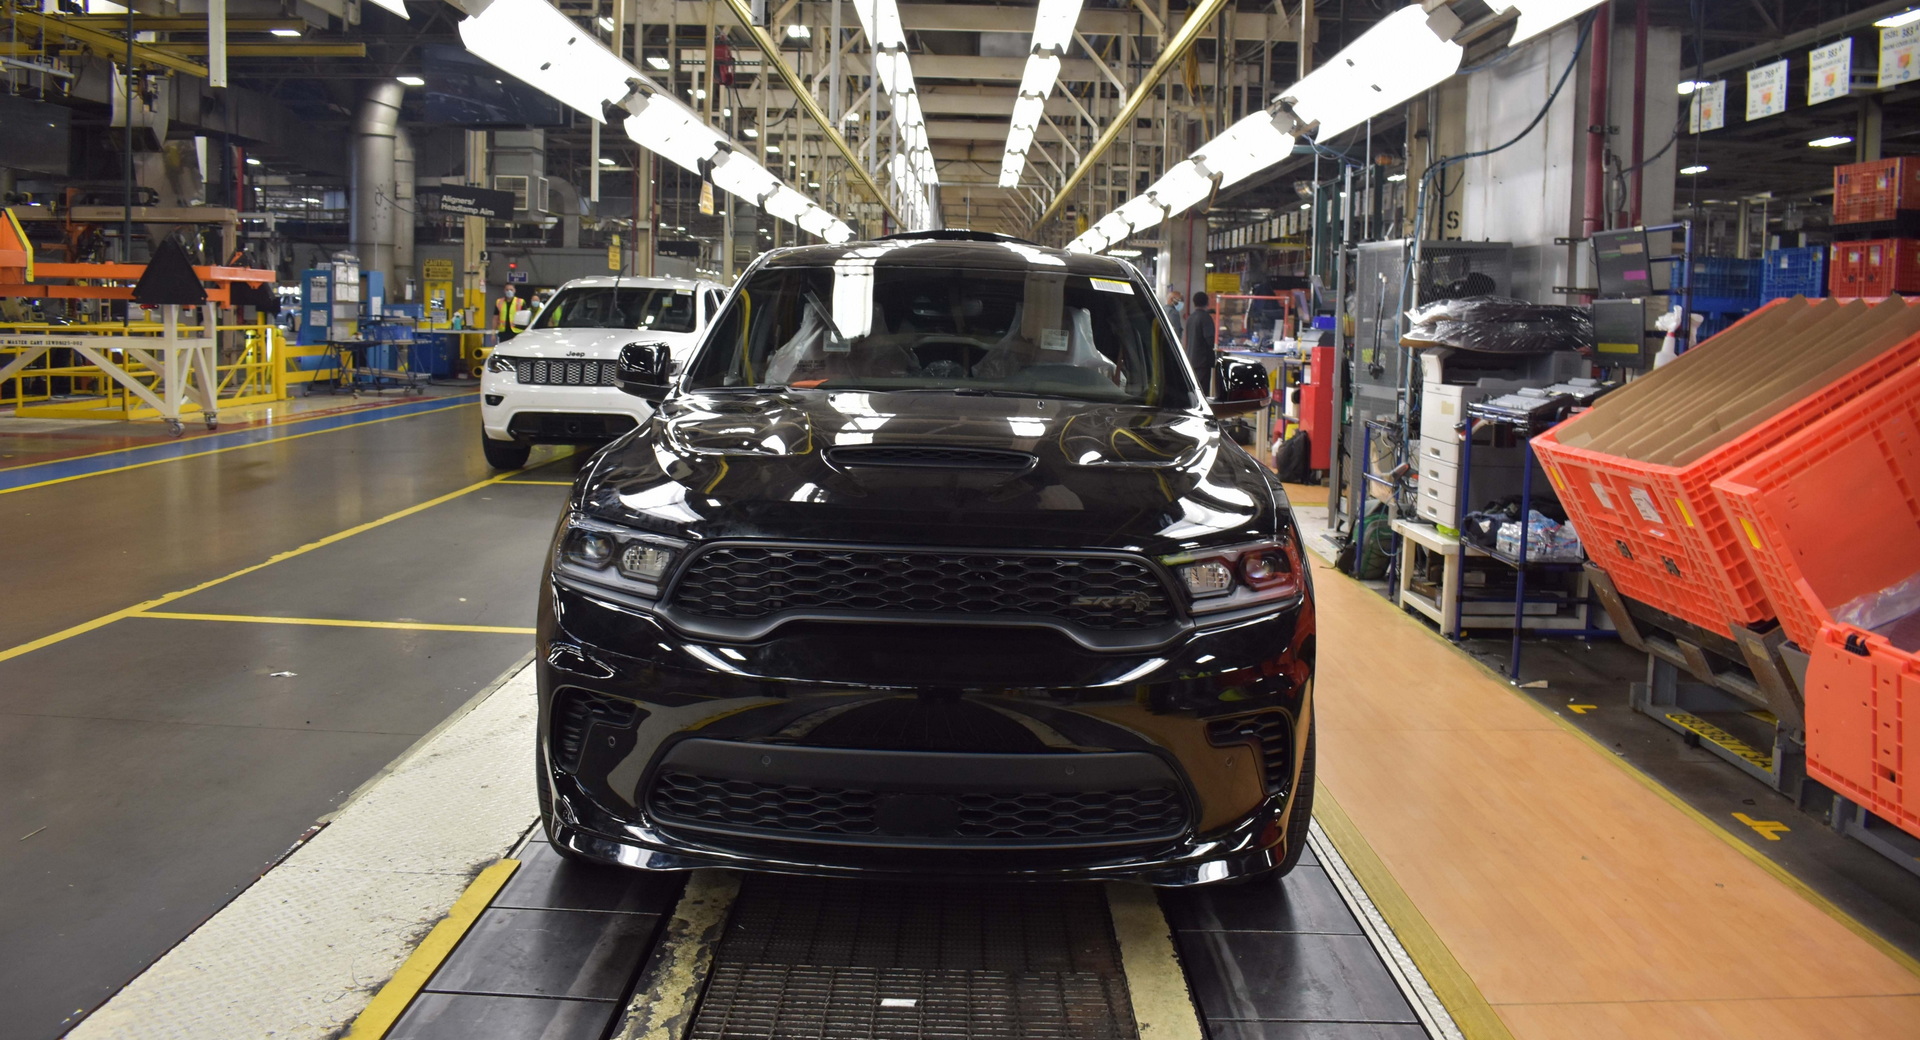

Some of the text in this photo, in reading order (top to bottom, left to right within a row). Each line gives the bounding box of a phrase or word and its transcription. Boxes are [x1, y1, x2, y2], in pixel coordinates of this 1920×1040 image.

[441, 194, 475, 205] Aligners/
[441, 203, 495, 216] Headlamp Aim
[1446, 210, 1460, 230] S
[1072, 596, 1136, 608] SRT
